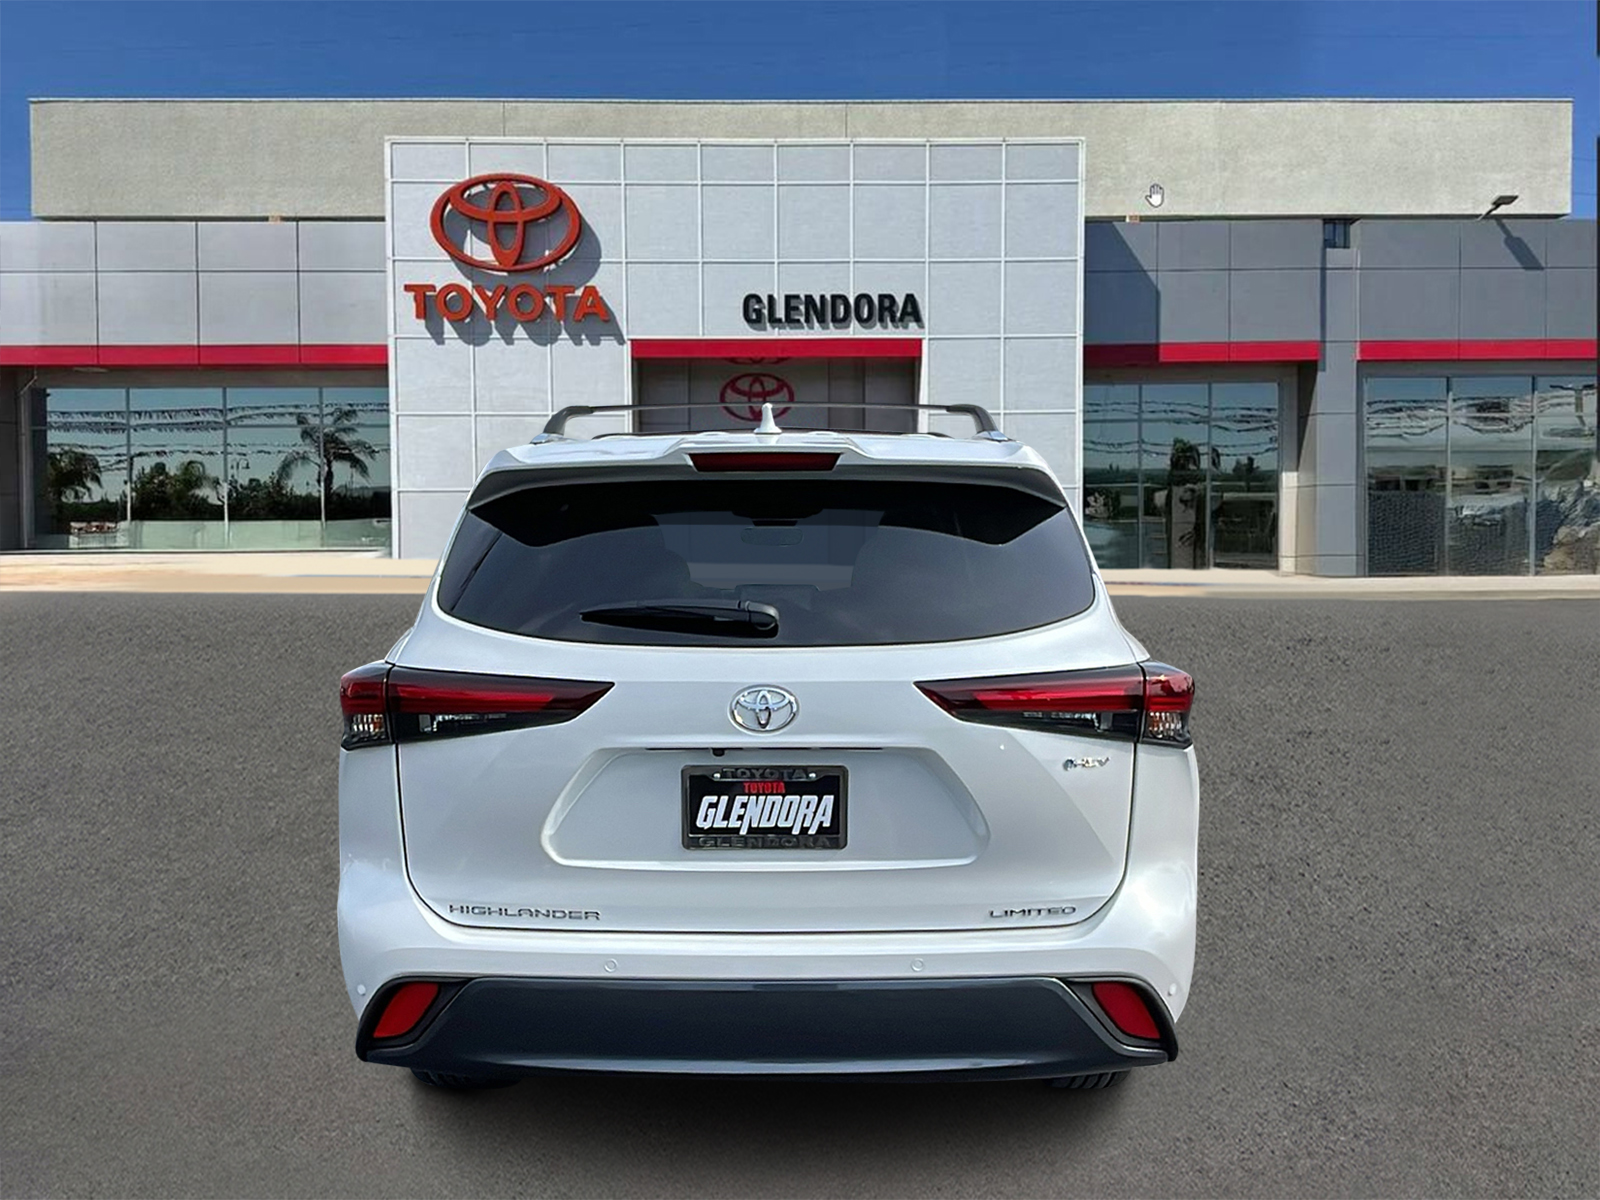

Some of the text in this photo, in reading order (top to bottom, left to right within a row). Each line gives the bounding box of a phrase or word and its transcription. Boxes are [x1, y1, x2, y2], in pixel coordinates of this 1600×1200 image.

[404, 283, 610, 323] TOYOTA
[742, 293, 922, 326] GLENDORA
[722, 768, 807, 780] TOYOTA
[743, 781, 785, 793] TOYOTA
[696, 795, 834, 835] GLENDORA
[699, 836, 832, 848] GLENDORA
[449, 905, 600, 920] HIGHLANDER
[989, 906, 1076, 918] LIMITED
